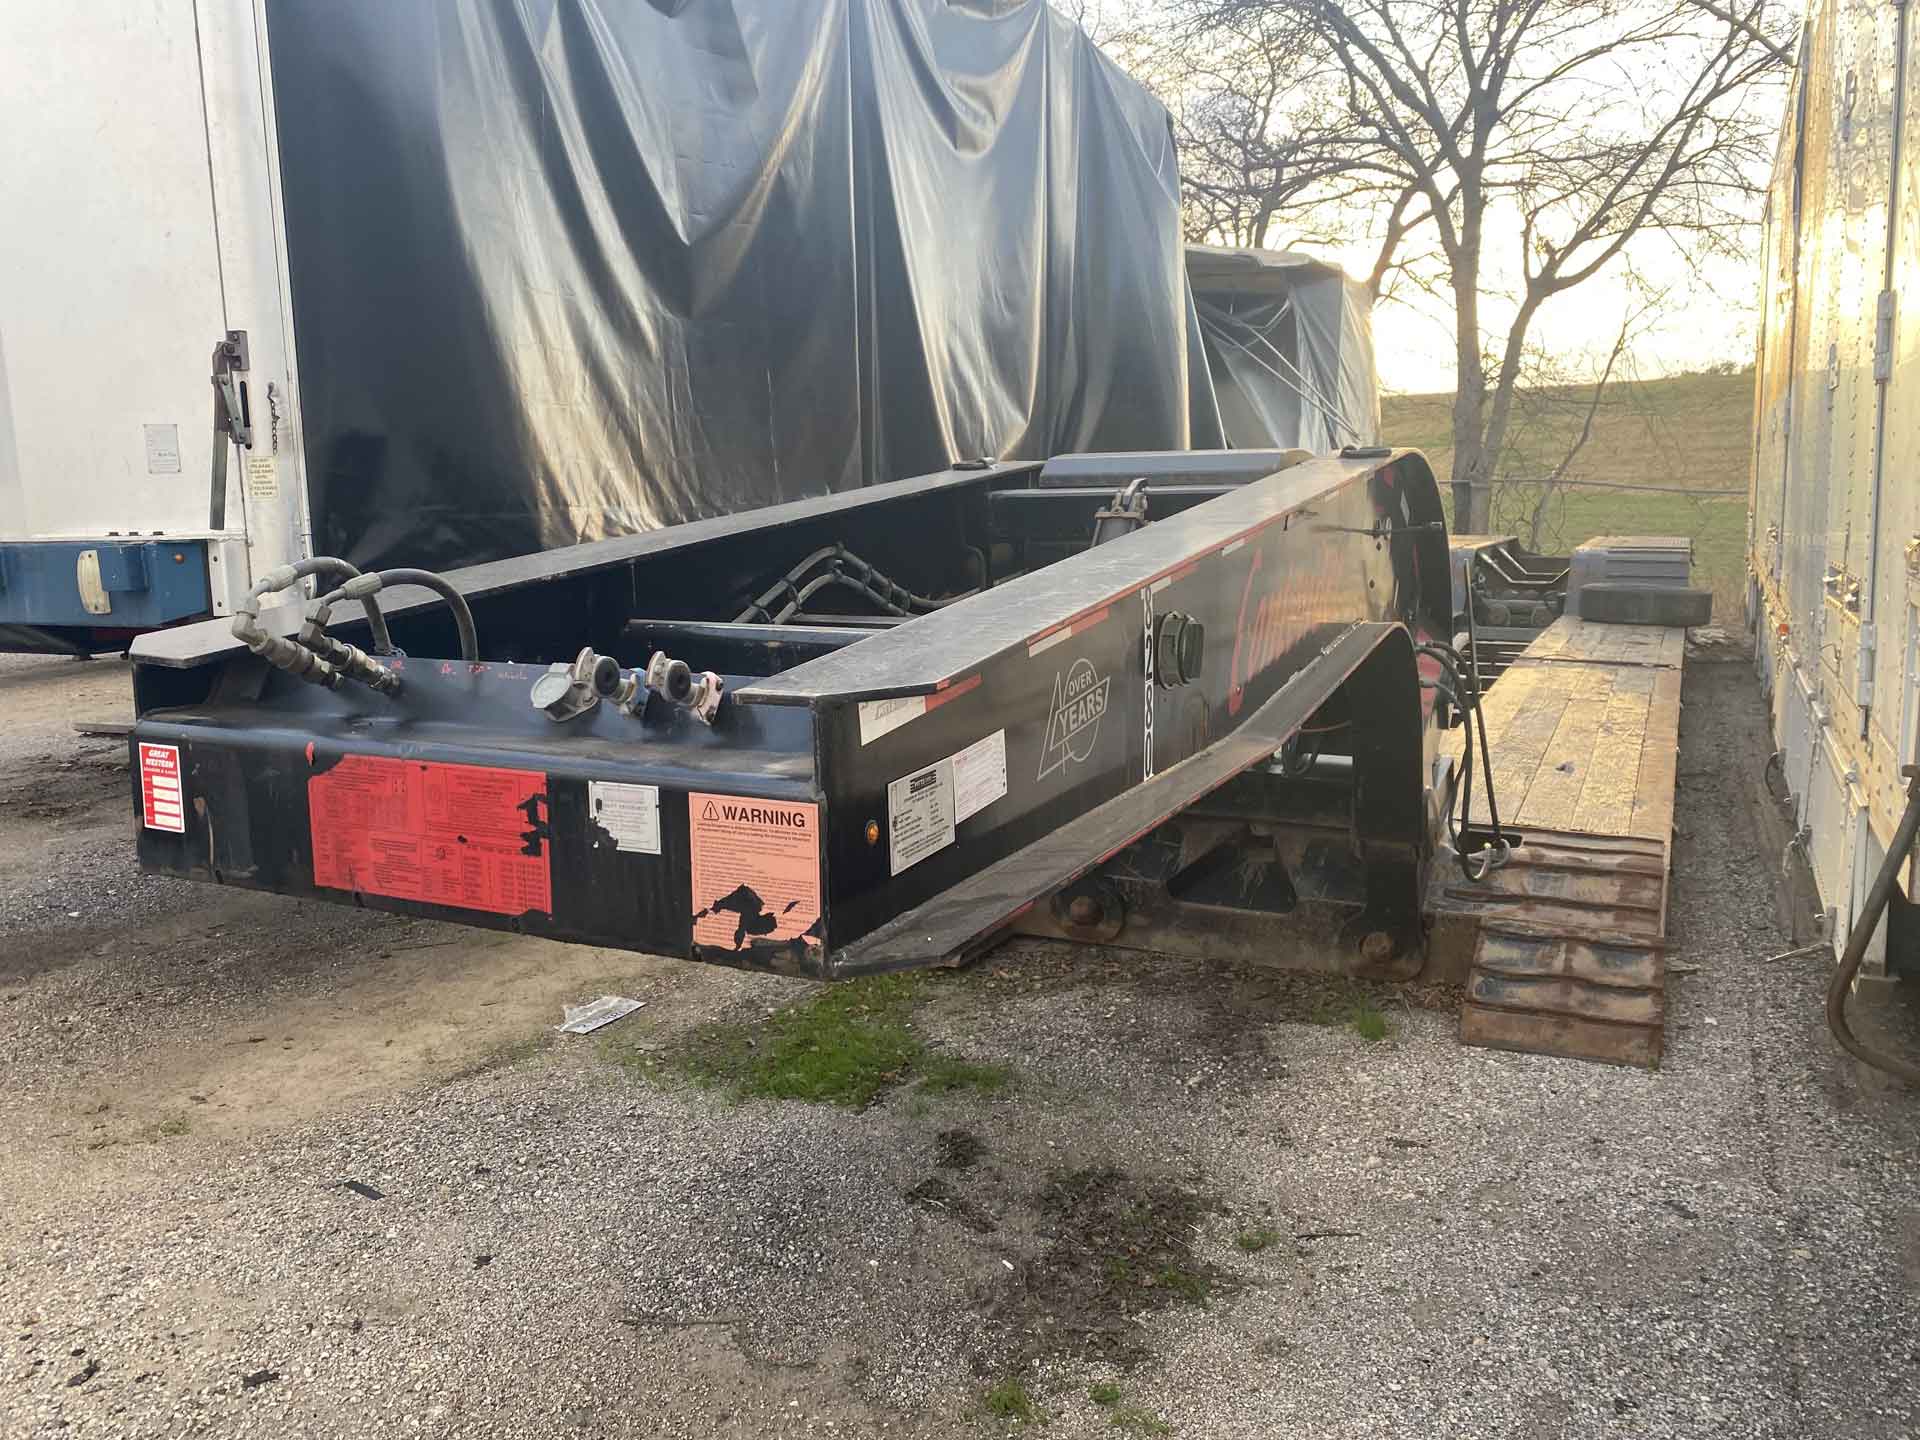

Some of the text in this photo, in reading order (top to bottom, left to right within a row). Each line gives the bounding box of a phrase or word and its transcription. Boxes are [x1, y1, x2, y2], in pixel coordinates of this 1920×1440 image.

[1069, 669, 1093, 697] OVER
[1060, 688, 1103, 737] YEARS
[145, 758, 175, 769] WESTERN
[148, 749, 170, 760] GREAT
[722, 805, 805, 828] WARNING
